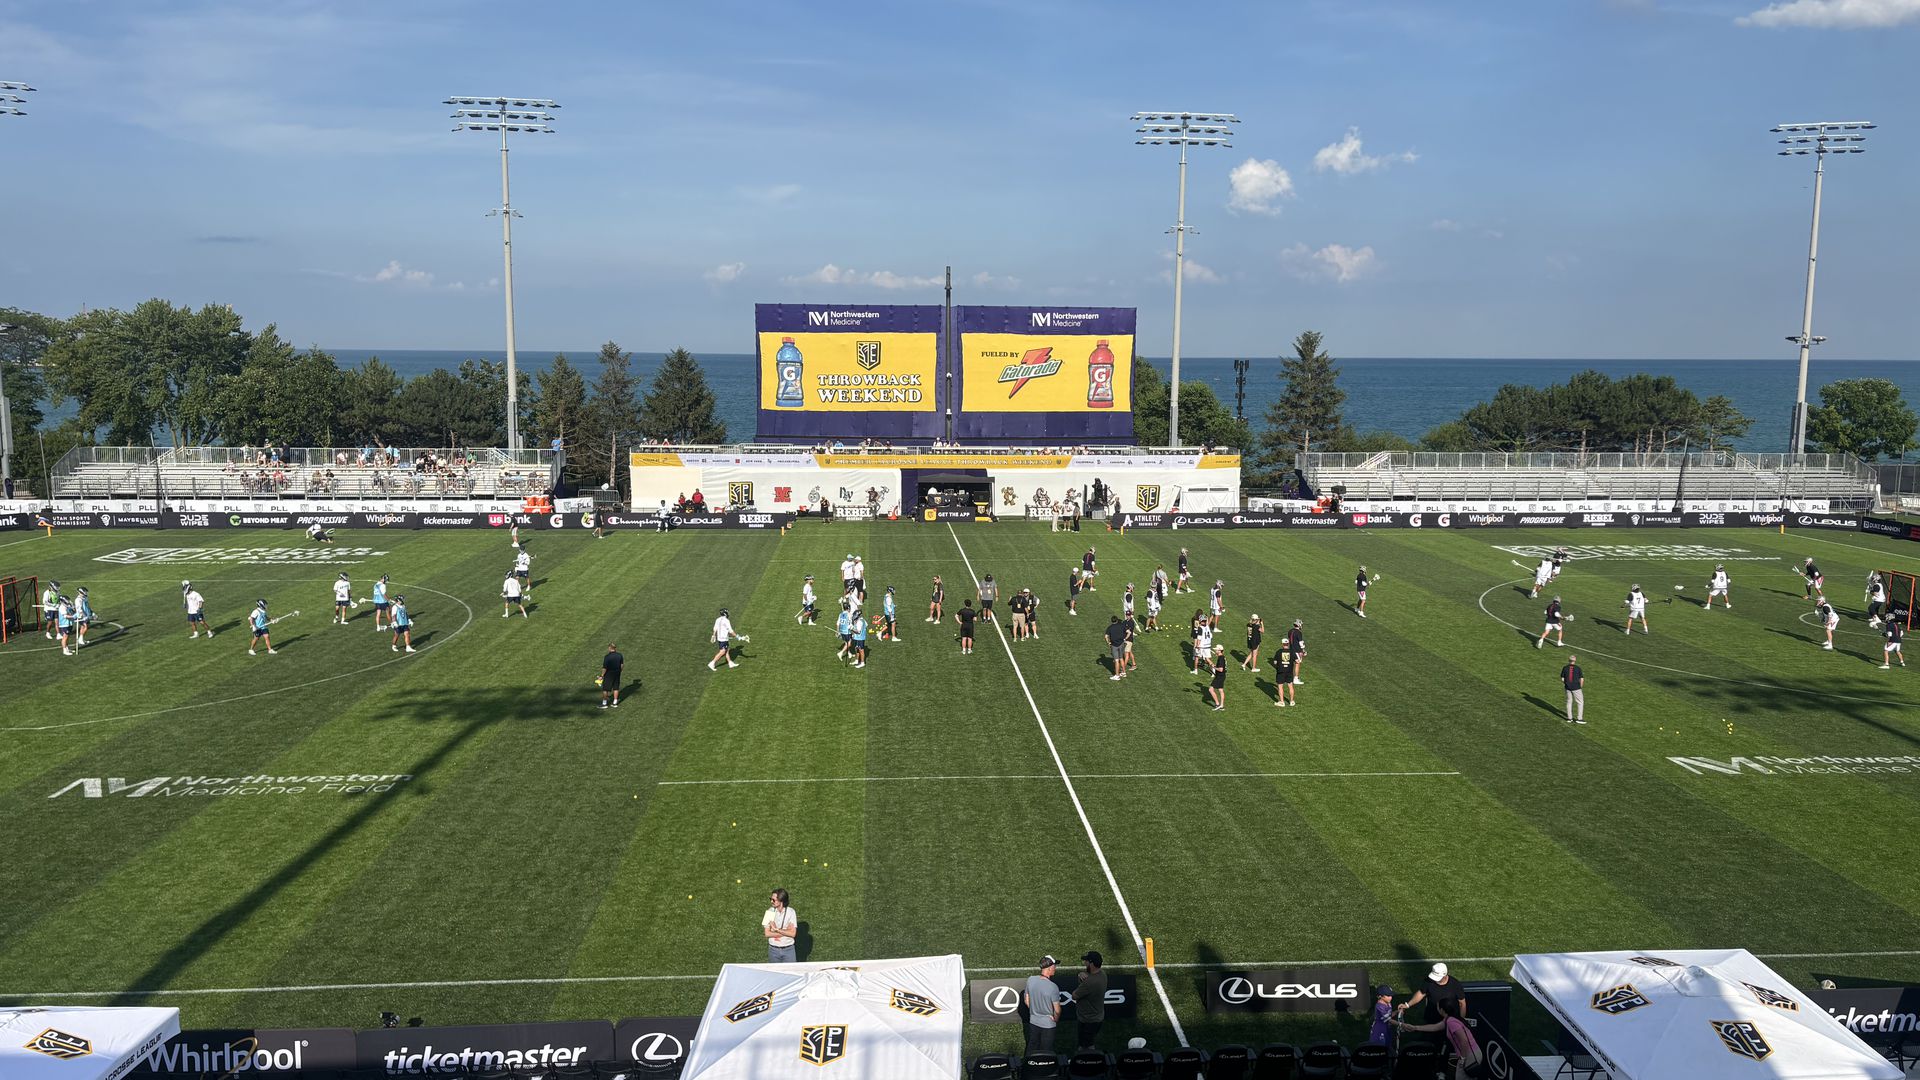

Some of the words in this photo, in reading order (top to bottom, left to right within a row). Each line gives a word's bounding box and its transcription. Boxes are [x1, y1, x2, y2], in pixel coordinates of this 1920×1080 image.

[783, 366, 796, 381] G
[1000, 360, 1059, 380] Gatorade
[1094, 368, 1106, 383] G
[817, 374, 921, 386] THROWBACK
[817, 388, 922, 403] WEEKEND
[739, 514, 774, 523] REBEL
[836, 507, 873, 517] REBEL
[1583, 514, 1614, 522] REBEL
[366, 514, 405, 525] Whirlpool
[424, 516, 473, 525] ticketmaster
[504, 514, 531, 524] bnk
[550, 514, 563, 528] G
[1233, 516, 1283, 526] Champion
[1292, 516, 1338, 524] ticketmaster
[1410, 514, 1421, 527] G
[1438, 514, 1450, 527] G
[1469, 514, 1504, 525] Whirlpool
[1750, 514, 1784, 525] Whirlpool
[1814, 518, 1857, 527] LEXUS
[172, 774, 413, 786] Northwestern
[154, 784, 306, 797] Medicine
[318, 783, 397, 794] Field
[1257, 983, 1357, 998] LEXUS
[733, 1002, 770, 1020] PLL
[1608, 997, 1644, 1012] PLL
[43, 1031, 86, 1047] PLL
[827, 1027, 842, 1057] PLL
[1737, 1023, 1767, 1052] PLL
[136, 1032, 162, 1058] LEAGUE
[149, 1040, 302, 1074] Whirlpool
[384, 1044, 586, 1074] ticketmaster
